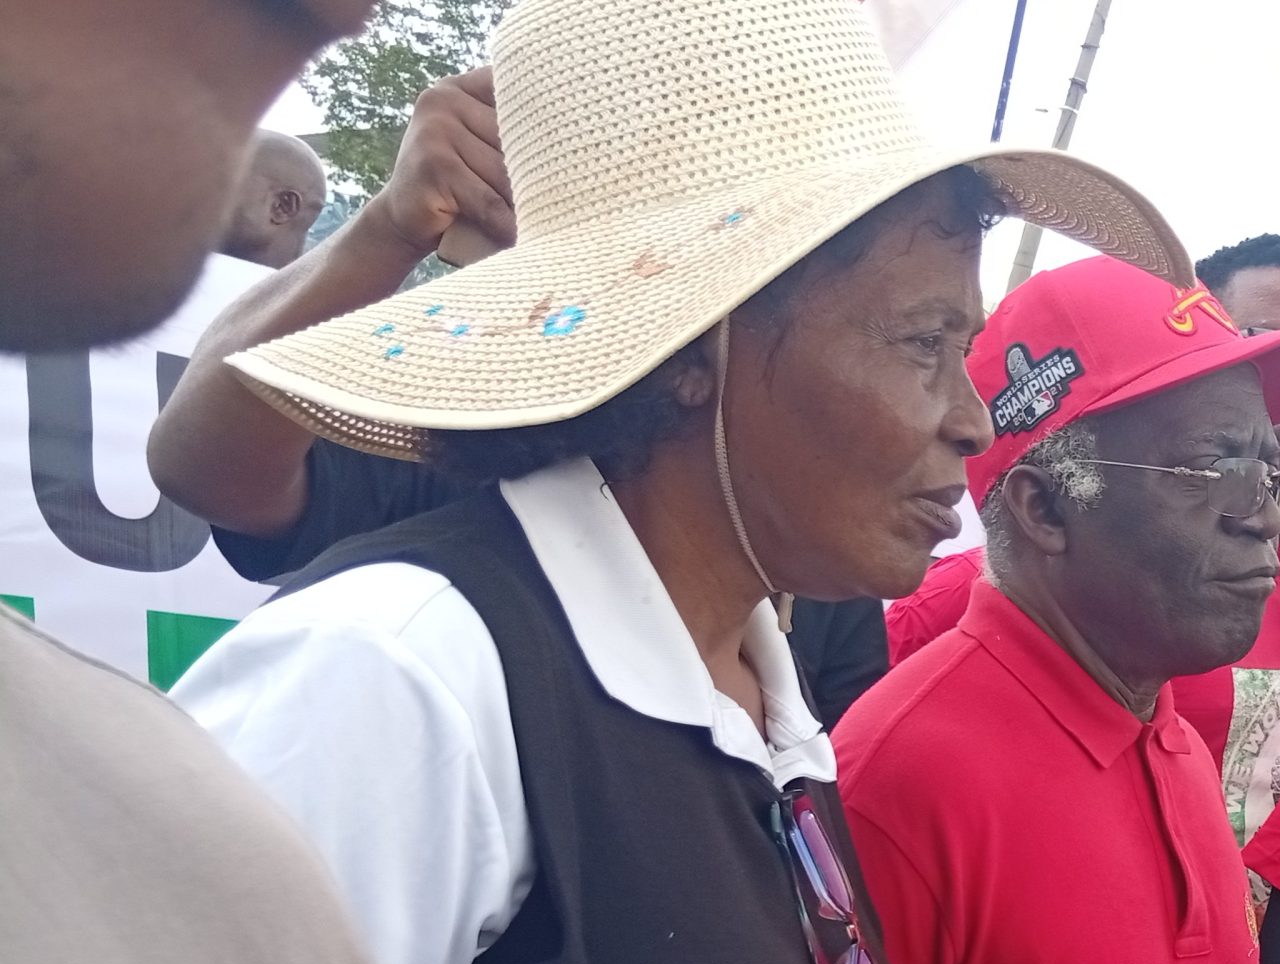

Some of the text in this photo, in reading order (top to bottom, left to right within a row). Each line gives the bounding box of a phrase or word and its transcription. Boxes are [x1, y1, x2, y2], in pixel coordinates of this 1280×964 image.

[995, 356, 1076, 429] CHAMPIONS
[996, 354, 1061, 407] WORLD SERIES
